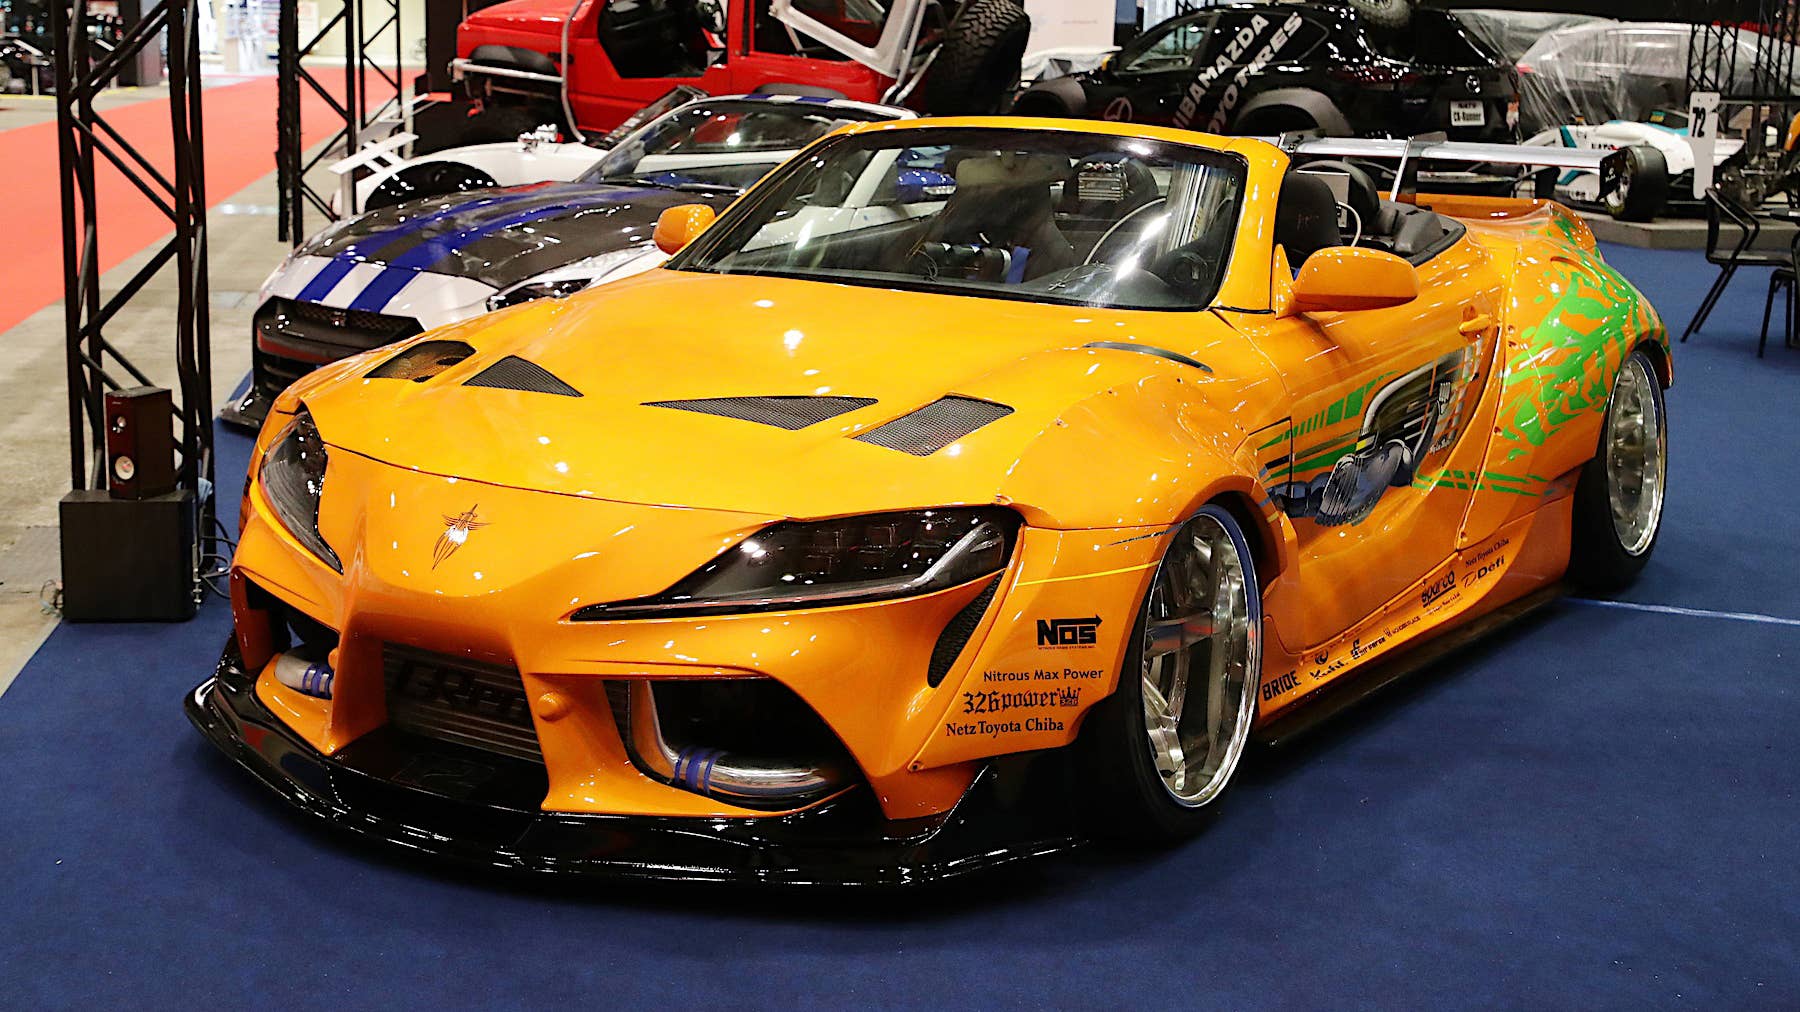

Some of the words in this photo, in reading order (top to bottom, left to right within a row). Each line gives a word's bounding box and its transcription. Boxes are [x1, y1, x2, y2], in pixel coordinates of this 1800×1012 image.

[1198, 13, 1270, 88] MAZDA
[1233, 10, 1304, 88] TIRES
[1691, 106, 1707, 138] 72
[1477, 554, 1505, 579] Defi
[1421, 570, 1456, 606] sparco
[983, 671, 1030, 682] Nitrous
[1035, 669, 1059, 680] Max
[1063, 668, 1104, 679] Power
[1262, 670, 1302, 701] BRIDE
[962, 689, 1060, 714] 326power
[946, 722, 976, 737] Netz
[978, 720, 1022, 739] Toyota
[1025, 717, 1064, 732] Chiba
